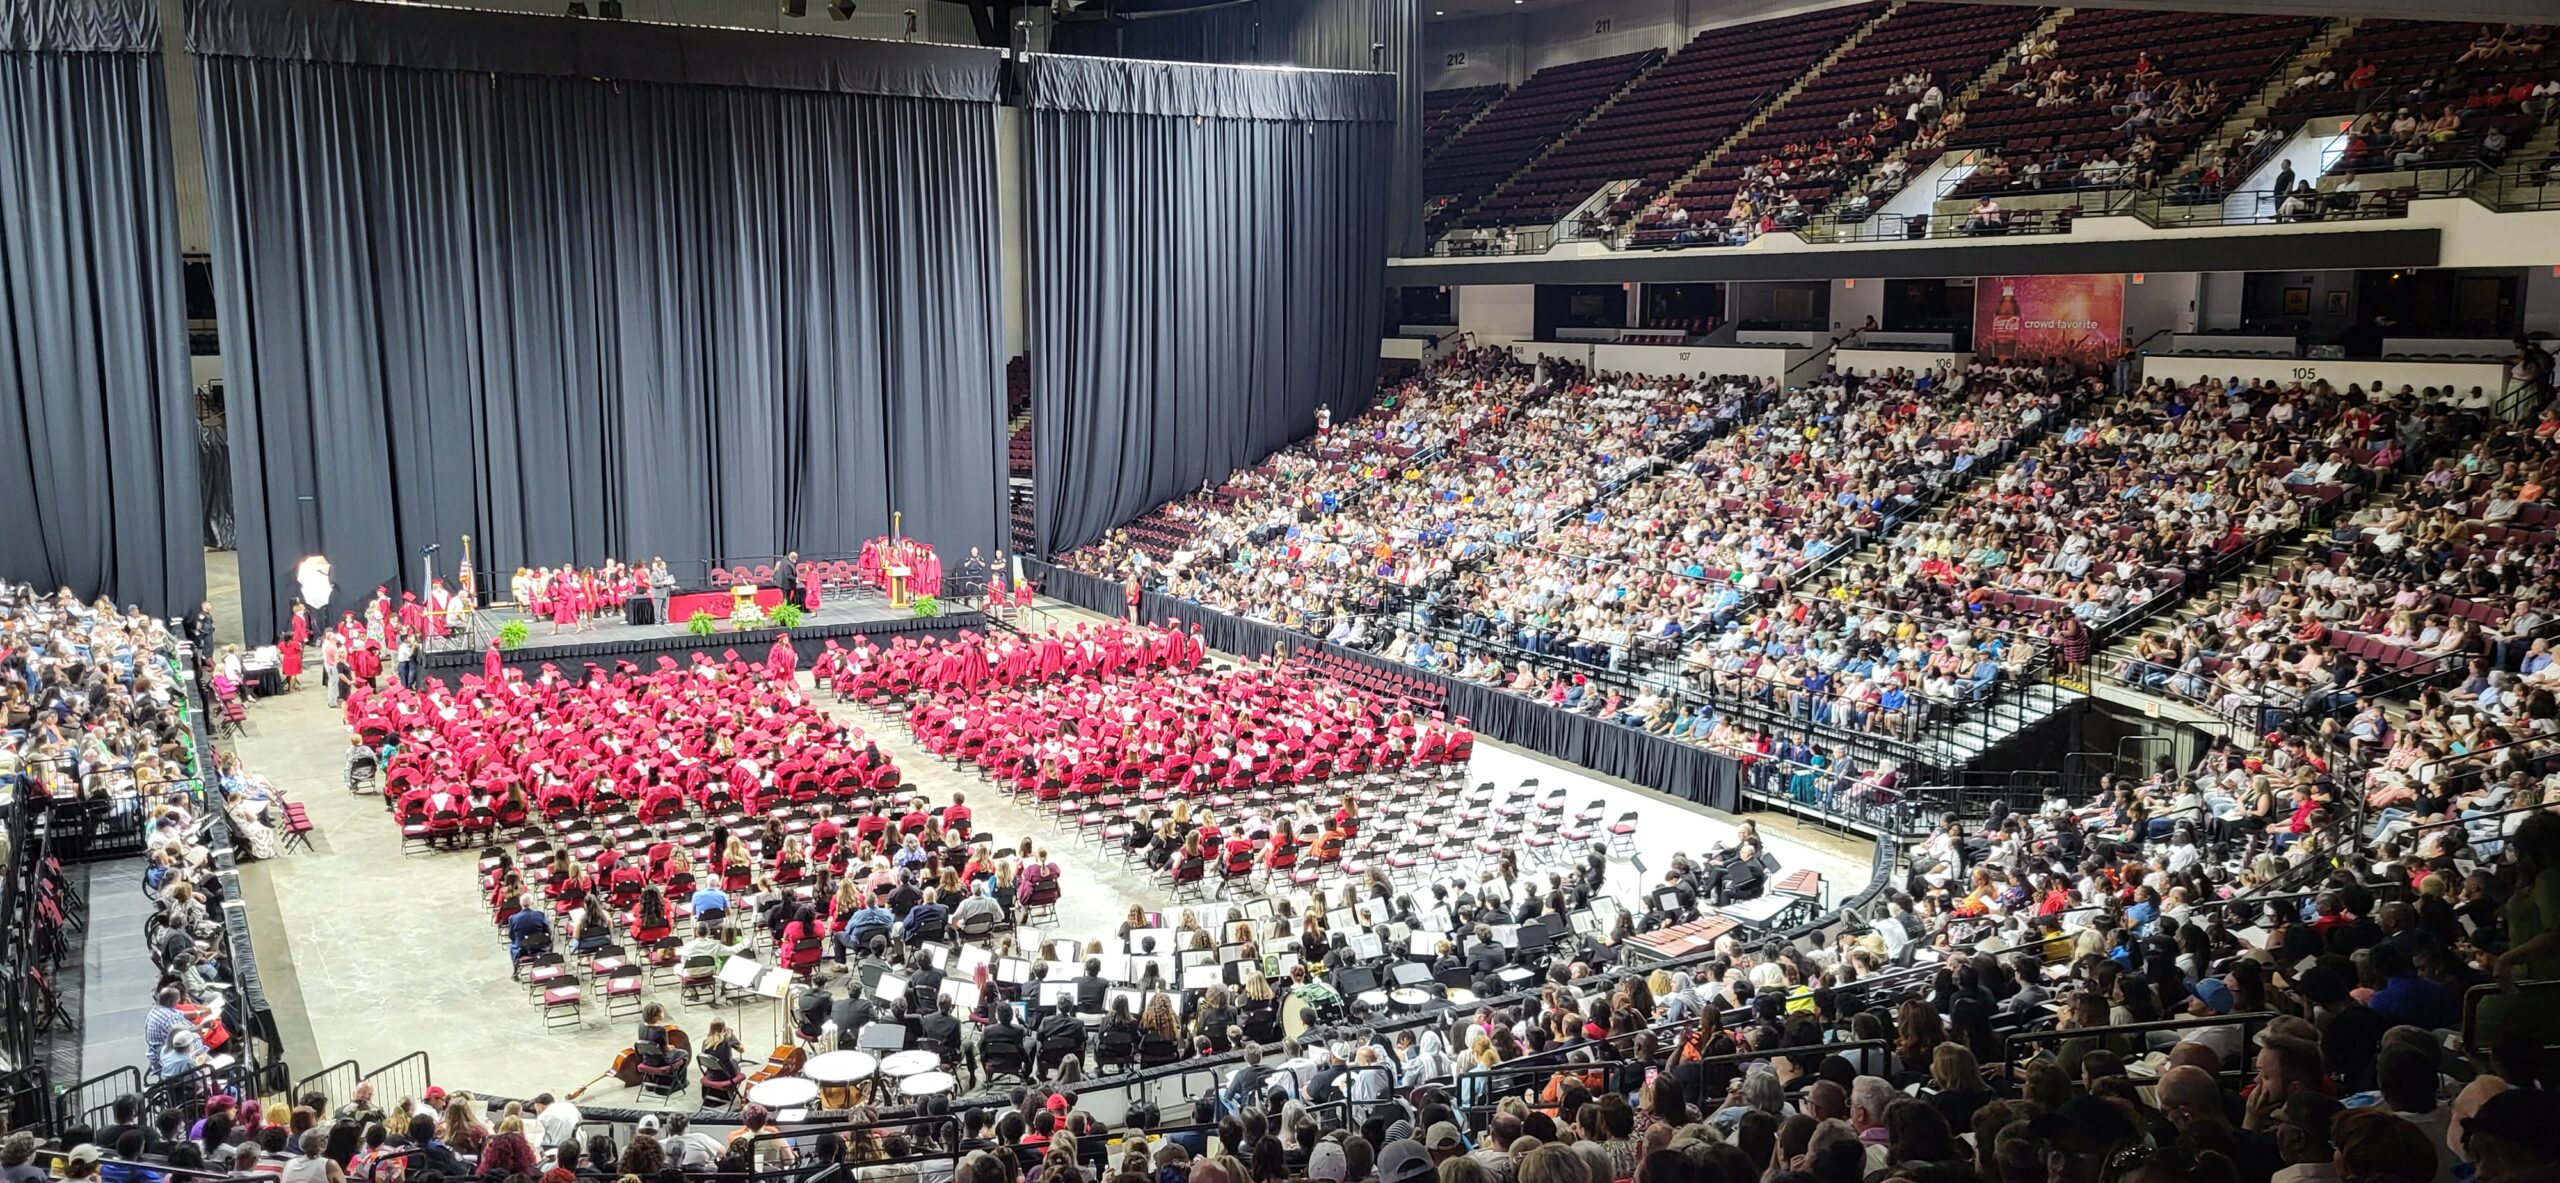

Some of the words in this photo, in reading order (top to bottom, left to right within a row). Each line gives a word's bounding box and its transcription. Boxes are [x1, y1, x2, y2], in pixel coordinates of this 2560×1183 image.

[1595, 19, 1610, 33] 211
[1446, 52, 1465, 66] 212
[2024, 320, 2055, 329] crowd
[2057, 320, 2098, 329] favorite
[1679, 352, 1691, 361] 107
[1935, 358, 1952, 368] 106
[2291, 367, 2316, 380] 105
